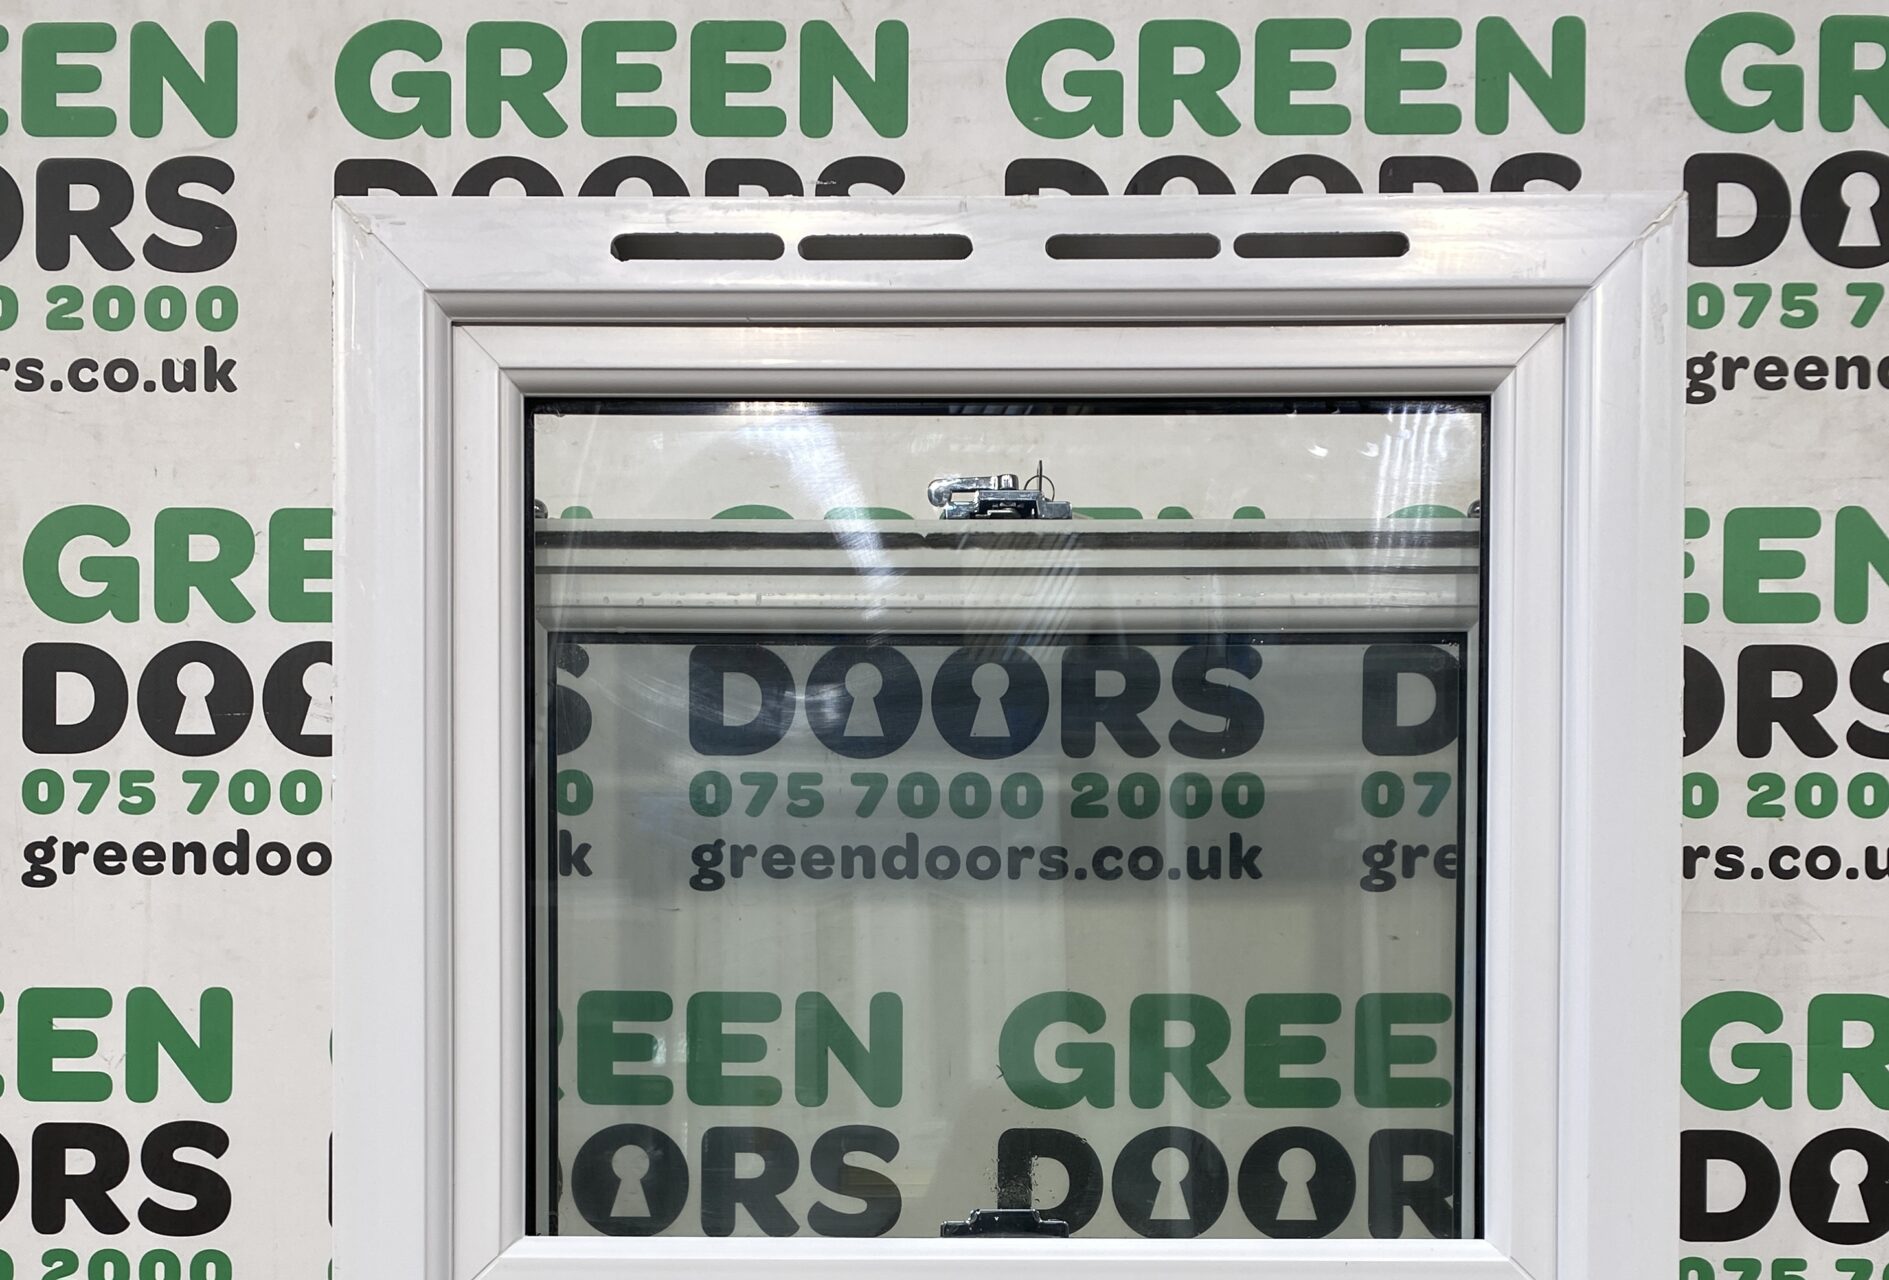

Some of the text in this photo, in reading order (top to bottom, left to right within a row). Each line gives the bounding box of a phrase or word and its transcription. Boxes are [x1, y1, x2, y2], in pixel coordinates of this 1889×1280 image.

[0, 20, 238, 138] EN
[334, 19, 909, 139] GREEN
[1005, 17, 1586, 139] GREEN
[0, 156, 237, 273] RS
[46, 285, 239, 332] 2000
[1686, 282, 1820, 330] 075
[689, 645, 1265, 760] DOORS
[22, 768, 332, 816] 075 700
[689, 770, 1266, 820] 075 7000 2000
[689, 832, 1264, 892] greendoors.co.uk
[0, 986, 233, 1104] EN
[557, 990, 904, 1108] EEN
[998, 990, 1454, 1110] GREE
[0, 1120, 232, 1237] RS
[557, 1123, 903, 1238] ORS
[997, 1125, 1455, 1239] DOOR
